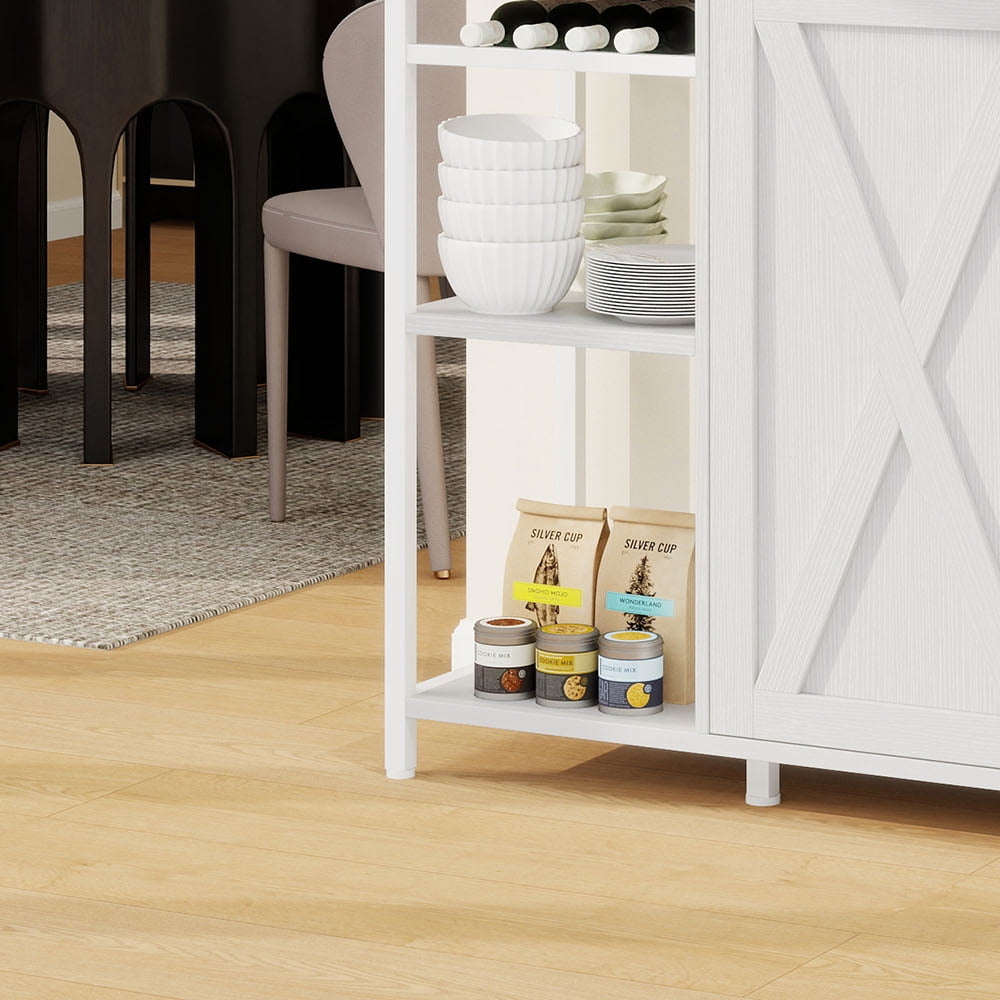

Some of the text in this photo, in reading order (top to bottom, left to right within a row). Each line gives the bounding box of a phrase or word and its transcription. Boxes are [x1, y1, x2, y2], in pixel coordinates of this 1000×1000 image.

[531, 528, 583, 542] SILVER CUP
[624, 538, 677, 554] SILVER CUP
[620, 598, 662, 608] WONDERLAND
